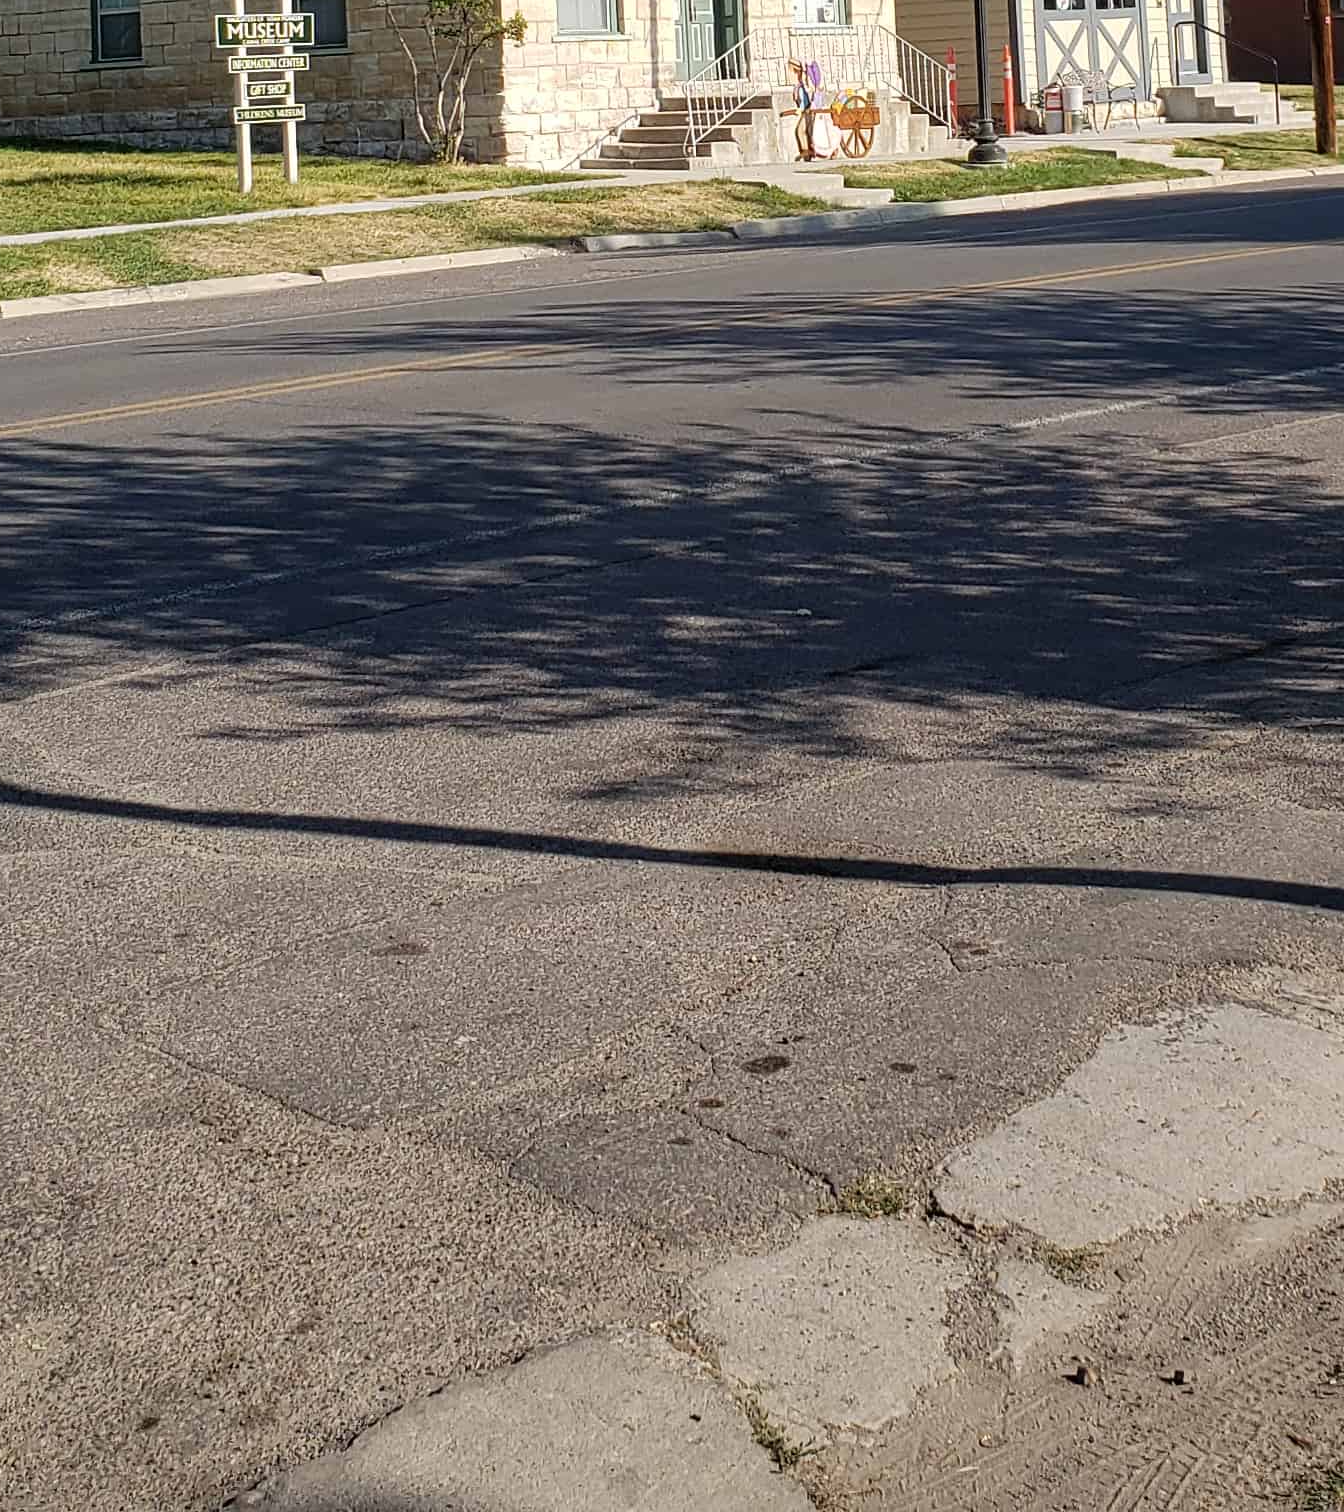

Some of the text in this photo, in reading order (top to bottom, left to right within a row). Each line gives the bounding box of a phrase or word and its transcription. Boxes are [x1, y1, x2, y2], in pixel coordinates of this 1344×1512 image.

[226, 22, 305, 40] MUSEUM
[232, 57, 305, 70] INFORMATION CENTER
[250, 83, 287, 96] GIFT SHOP
[276, 108, 304, 118] MUSEUM
